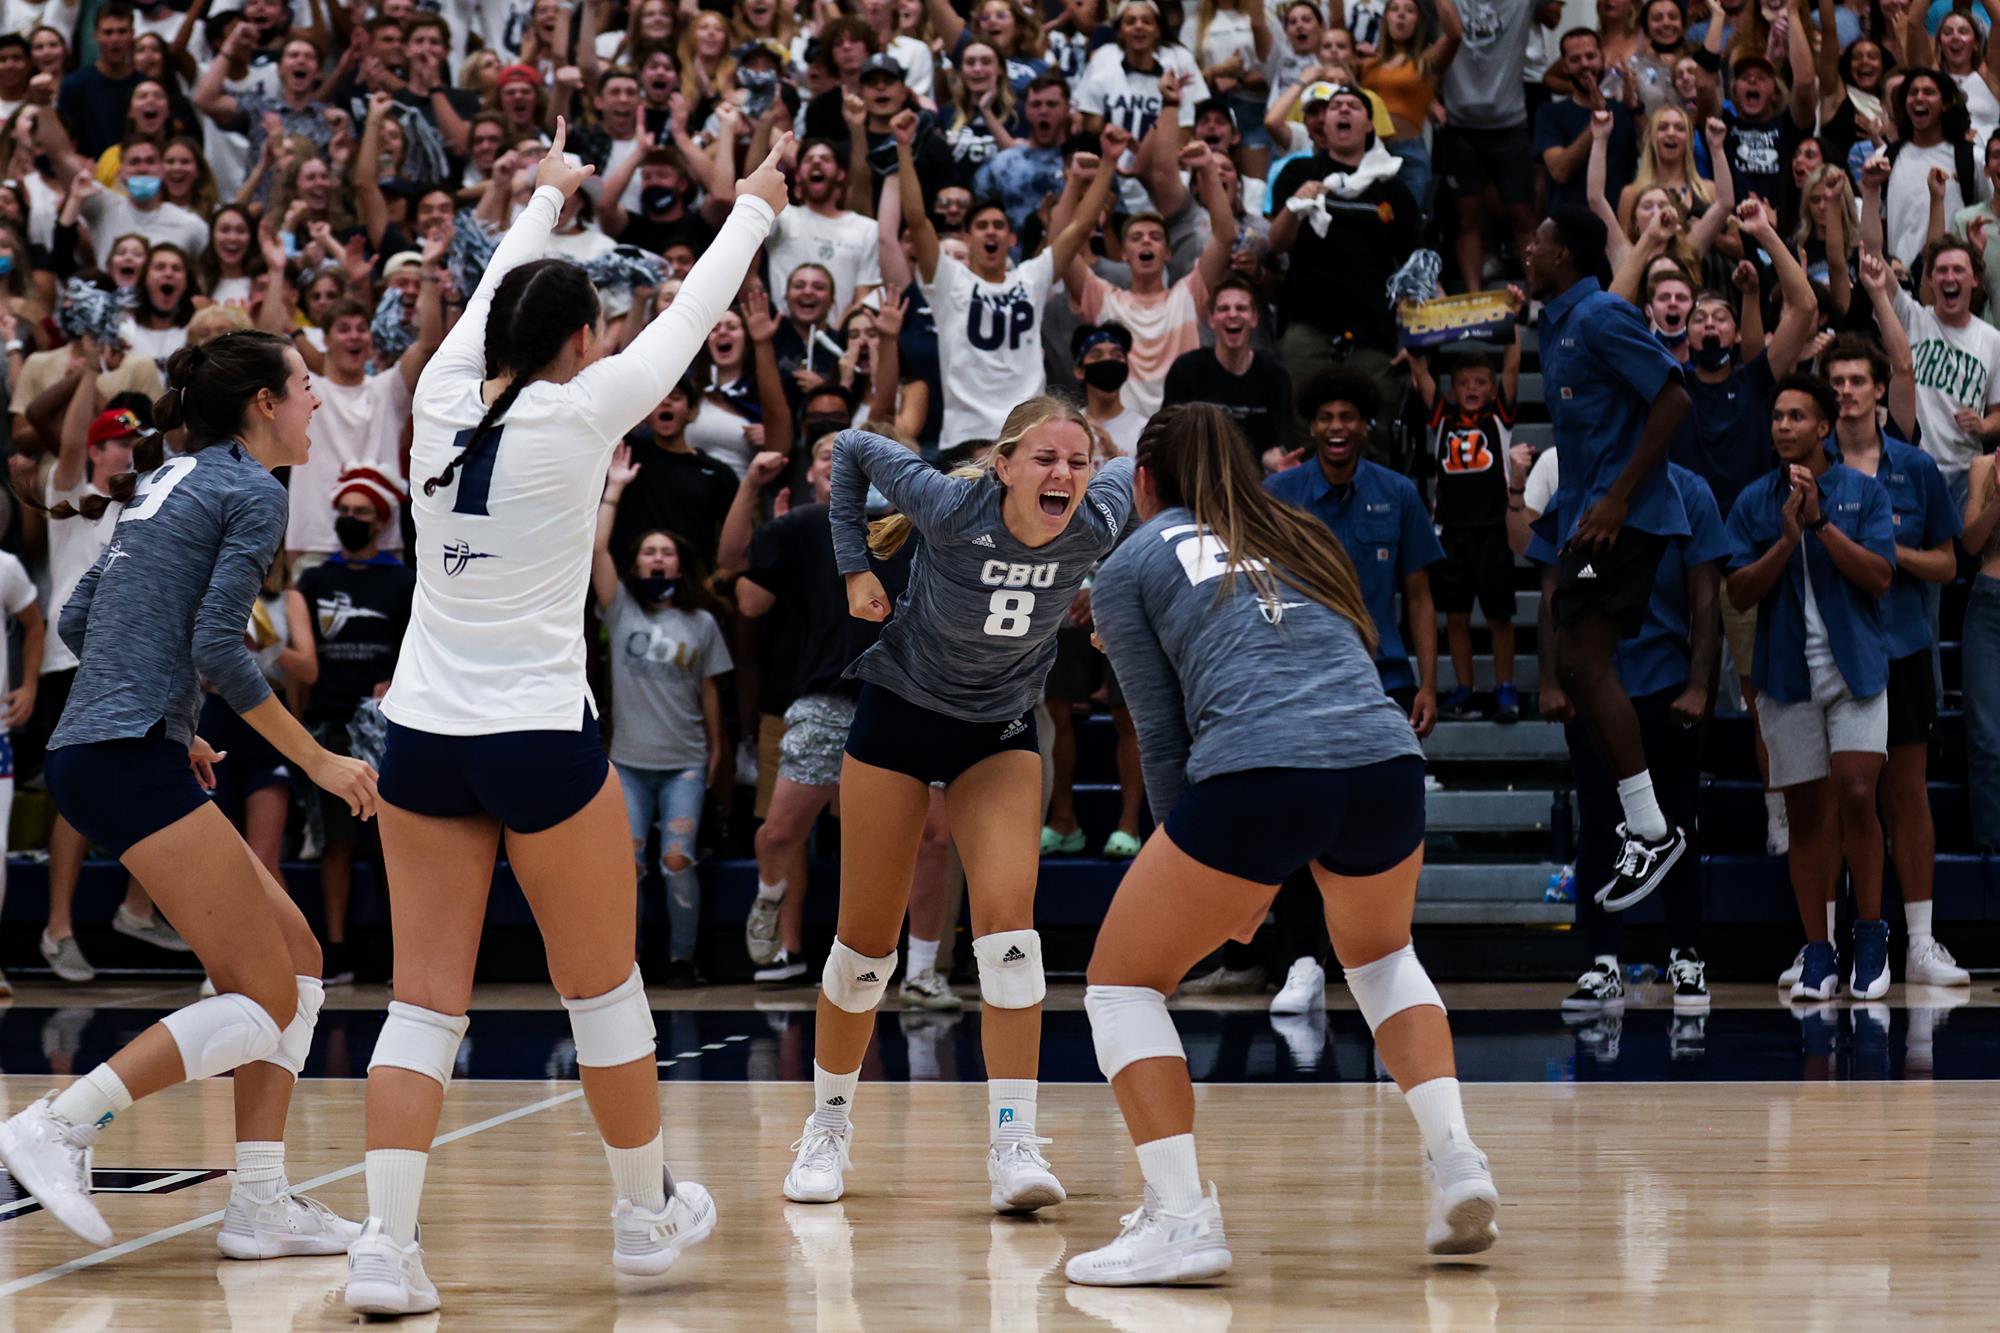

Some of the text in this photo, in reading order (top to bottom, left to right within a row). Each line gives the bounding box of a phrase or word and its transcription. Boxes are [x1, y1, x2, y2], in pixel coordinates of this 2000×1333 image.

[1103, 93, 1160, 113] LANC
[967, 299, 1035, 352] UP
[1911, 338, 1988, 412] ORGIVE
[971, 539, 997, 550] adidas
[980, 559, 1060, 588] CBU
[983, 589, 1036, 637] 8
[1000, 723, 1029, 741] adidas
